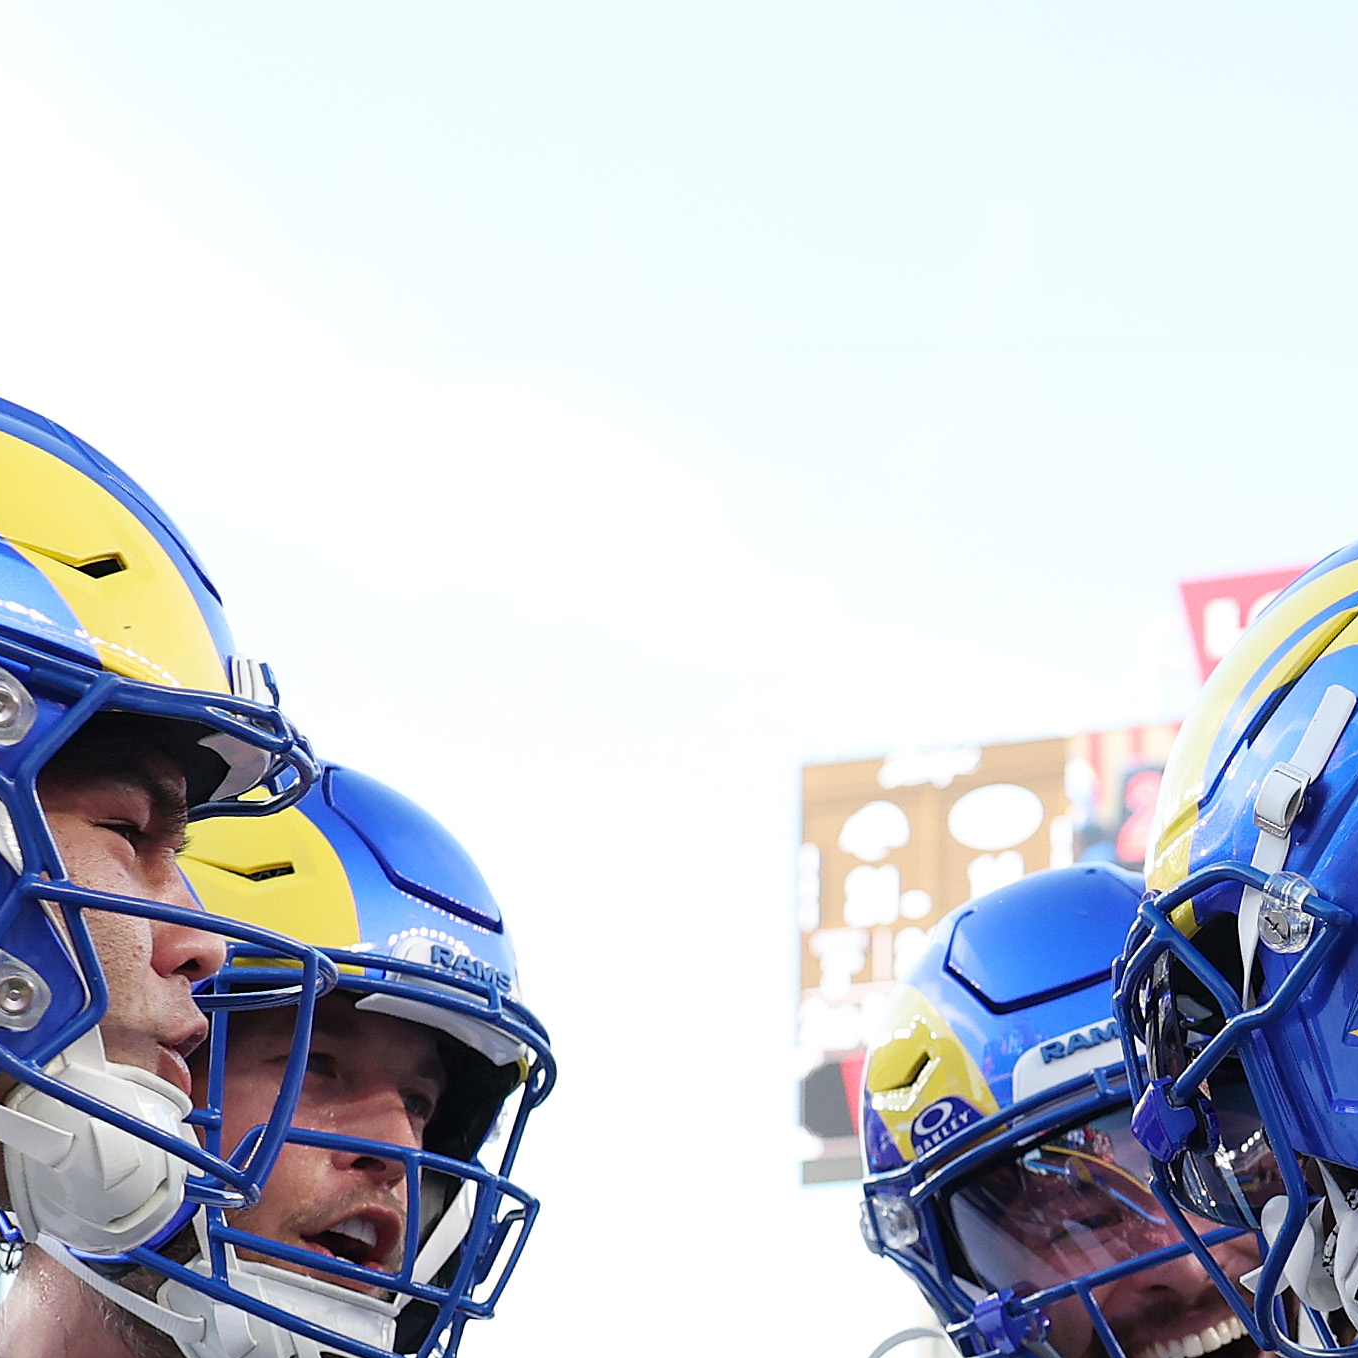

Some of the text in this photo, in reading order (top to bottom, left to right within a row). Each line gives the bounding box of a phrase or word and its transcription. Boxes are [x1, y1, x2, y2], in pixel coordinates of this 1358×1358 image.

[430, 944, 513, 994] RAMS
[1040, 1021, 1122, 1065] RAM
[915, 1109, 971, 1157] OAKLEY
